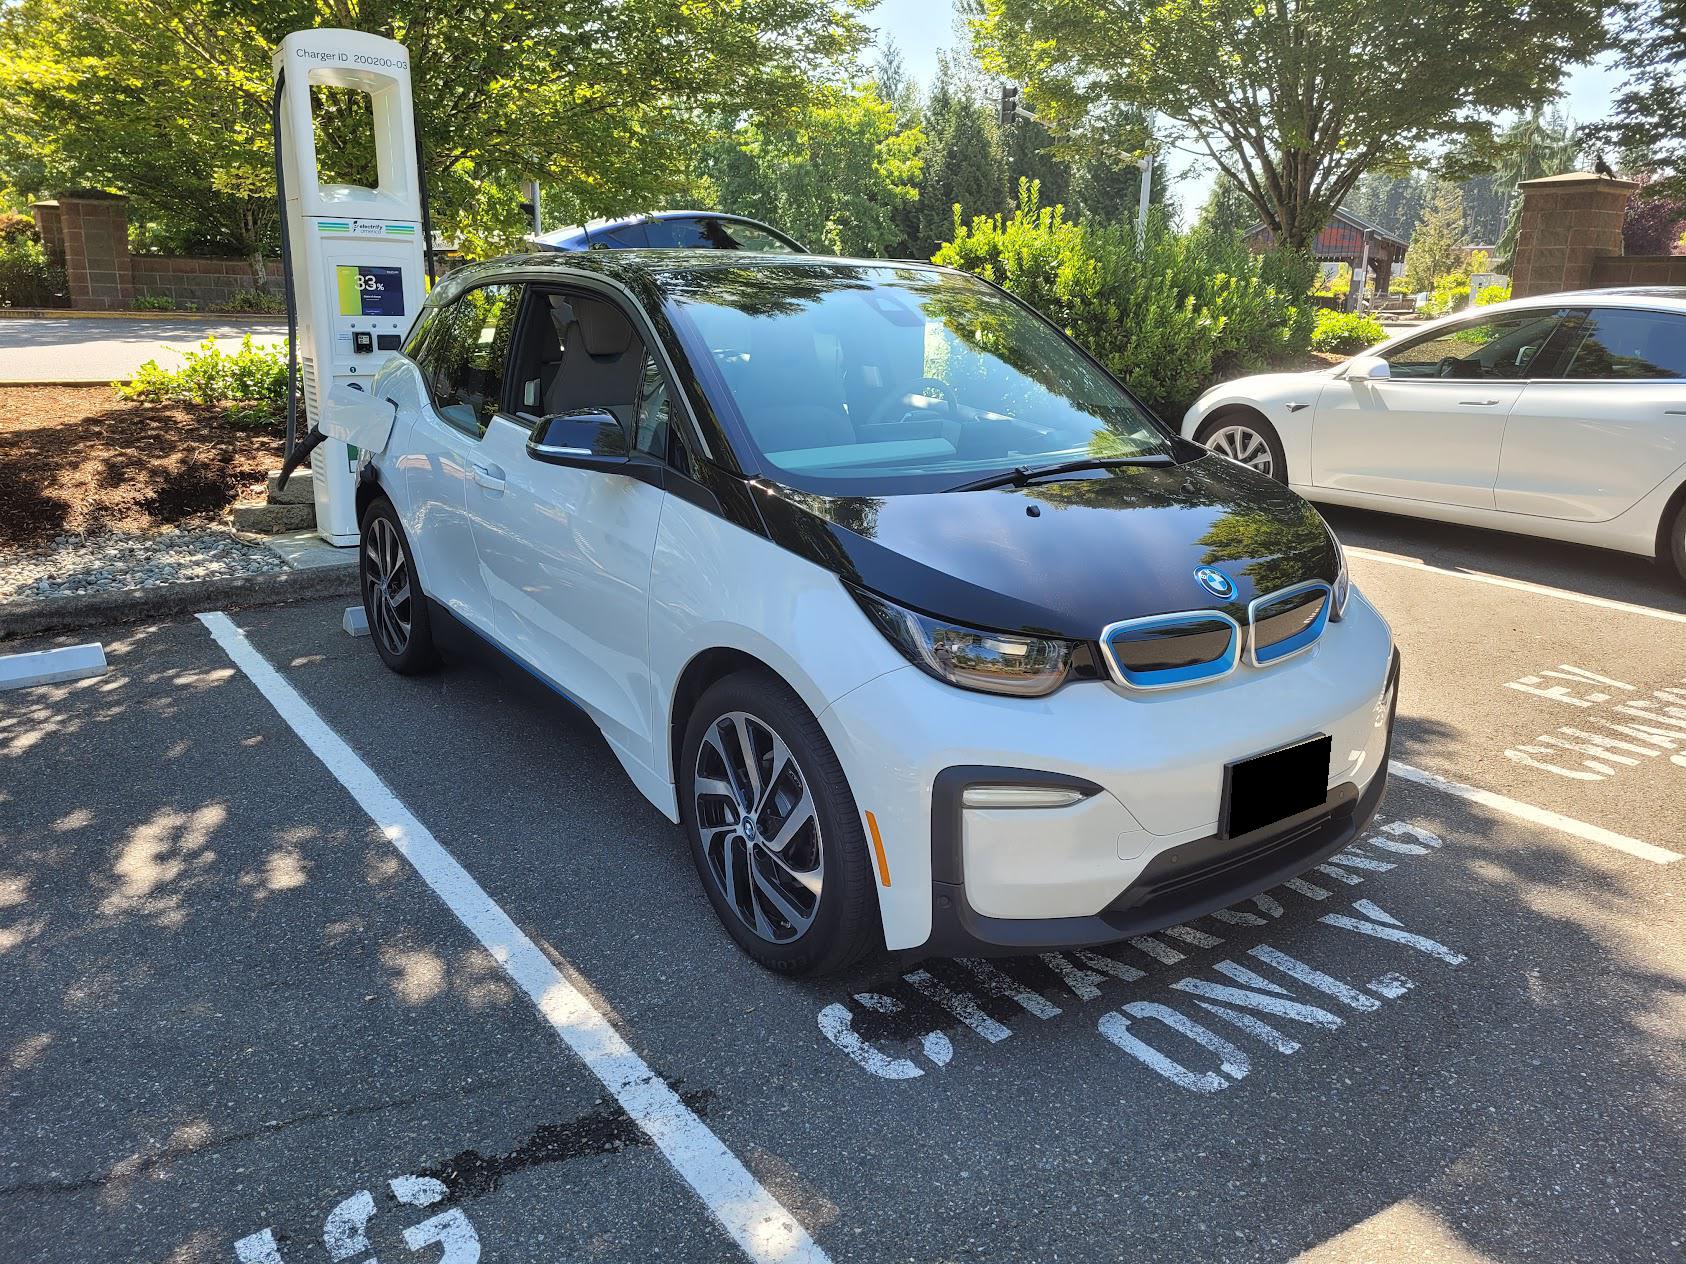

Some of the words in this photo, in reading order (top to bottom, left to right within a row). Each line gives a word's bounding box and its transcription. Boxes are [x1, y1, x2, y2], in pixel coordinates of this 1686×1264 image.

[296, 48, 336, 62] Charger
[338, 53, 349, 62] ID
[353, 54, 408, 70] 200200-03
[354, 275, 385, 291] 33%
[1503, 663, 1637, 708] EV
[1097, 898, 1467, 1092] ONLY
